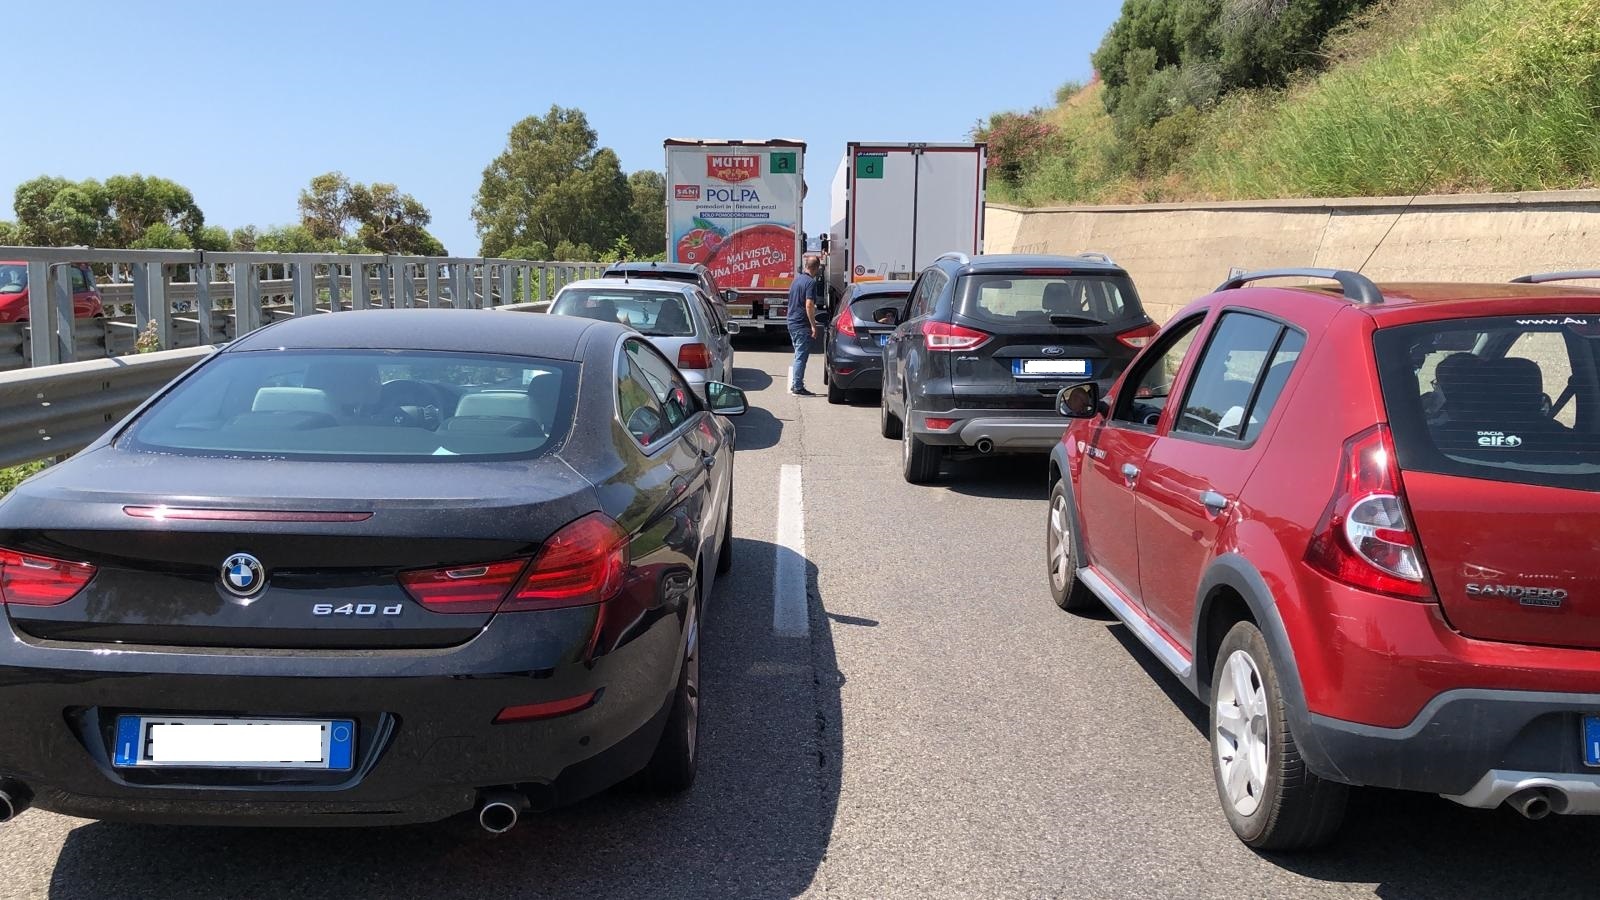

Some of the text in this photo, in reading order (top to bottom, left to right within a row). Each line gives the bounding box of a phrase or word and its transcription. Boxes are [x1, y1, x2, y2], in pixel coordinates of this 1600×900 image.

[712, 157, 754, 168] MUTTI
[777, 157, 789, 169] a
[866, 162, 873, 174] d
[706, 189, 760, 202] POLPA
[726, 251, 744, 264] MAI
[746, 246, 771, 259] VISTA
[732, 259, 760, 273] POLPA
[1477, 436, 1506, 445] elf
[227, 557, 258, 570] BMW
[1465, 583, 1568, 599] SANDERO
[312, 603, 404, 615] 640 d
